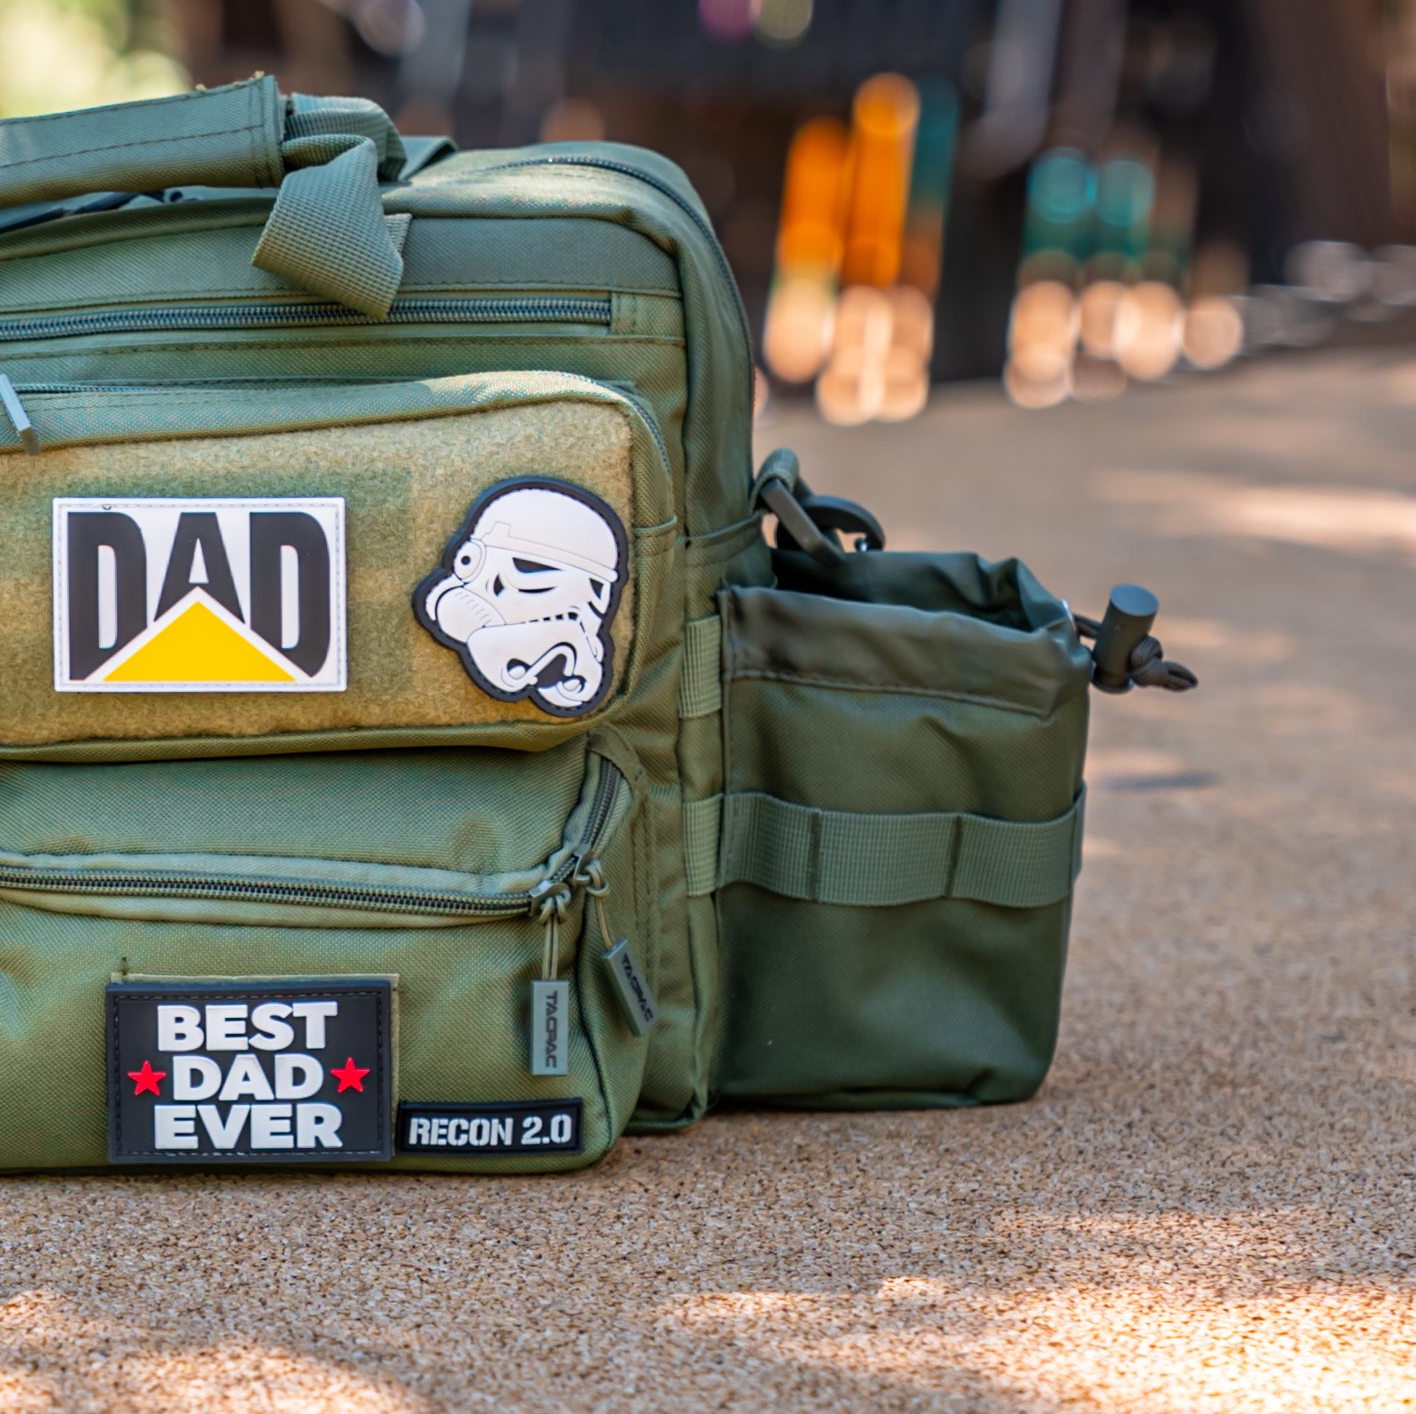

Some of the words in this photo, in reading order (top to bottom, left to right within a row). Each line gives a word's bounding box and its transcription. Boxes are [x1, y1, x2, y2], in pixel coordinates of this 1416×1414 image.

[67, 512, 331, 681] DAD
[157, 1001, 338, 1051] BEST
[545, 990, 558, 1068] TACPAC
[172, 1053, 324, 1101] DAD
[154, 1102, 343, 1149] EVER
[409, 1117, 514, 1146] RECON
[520, 1113, 572, 1145] 2.0
